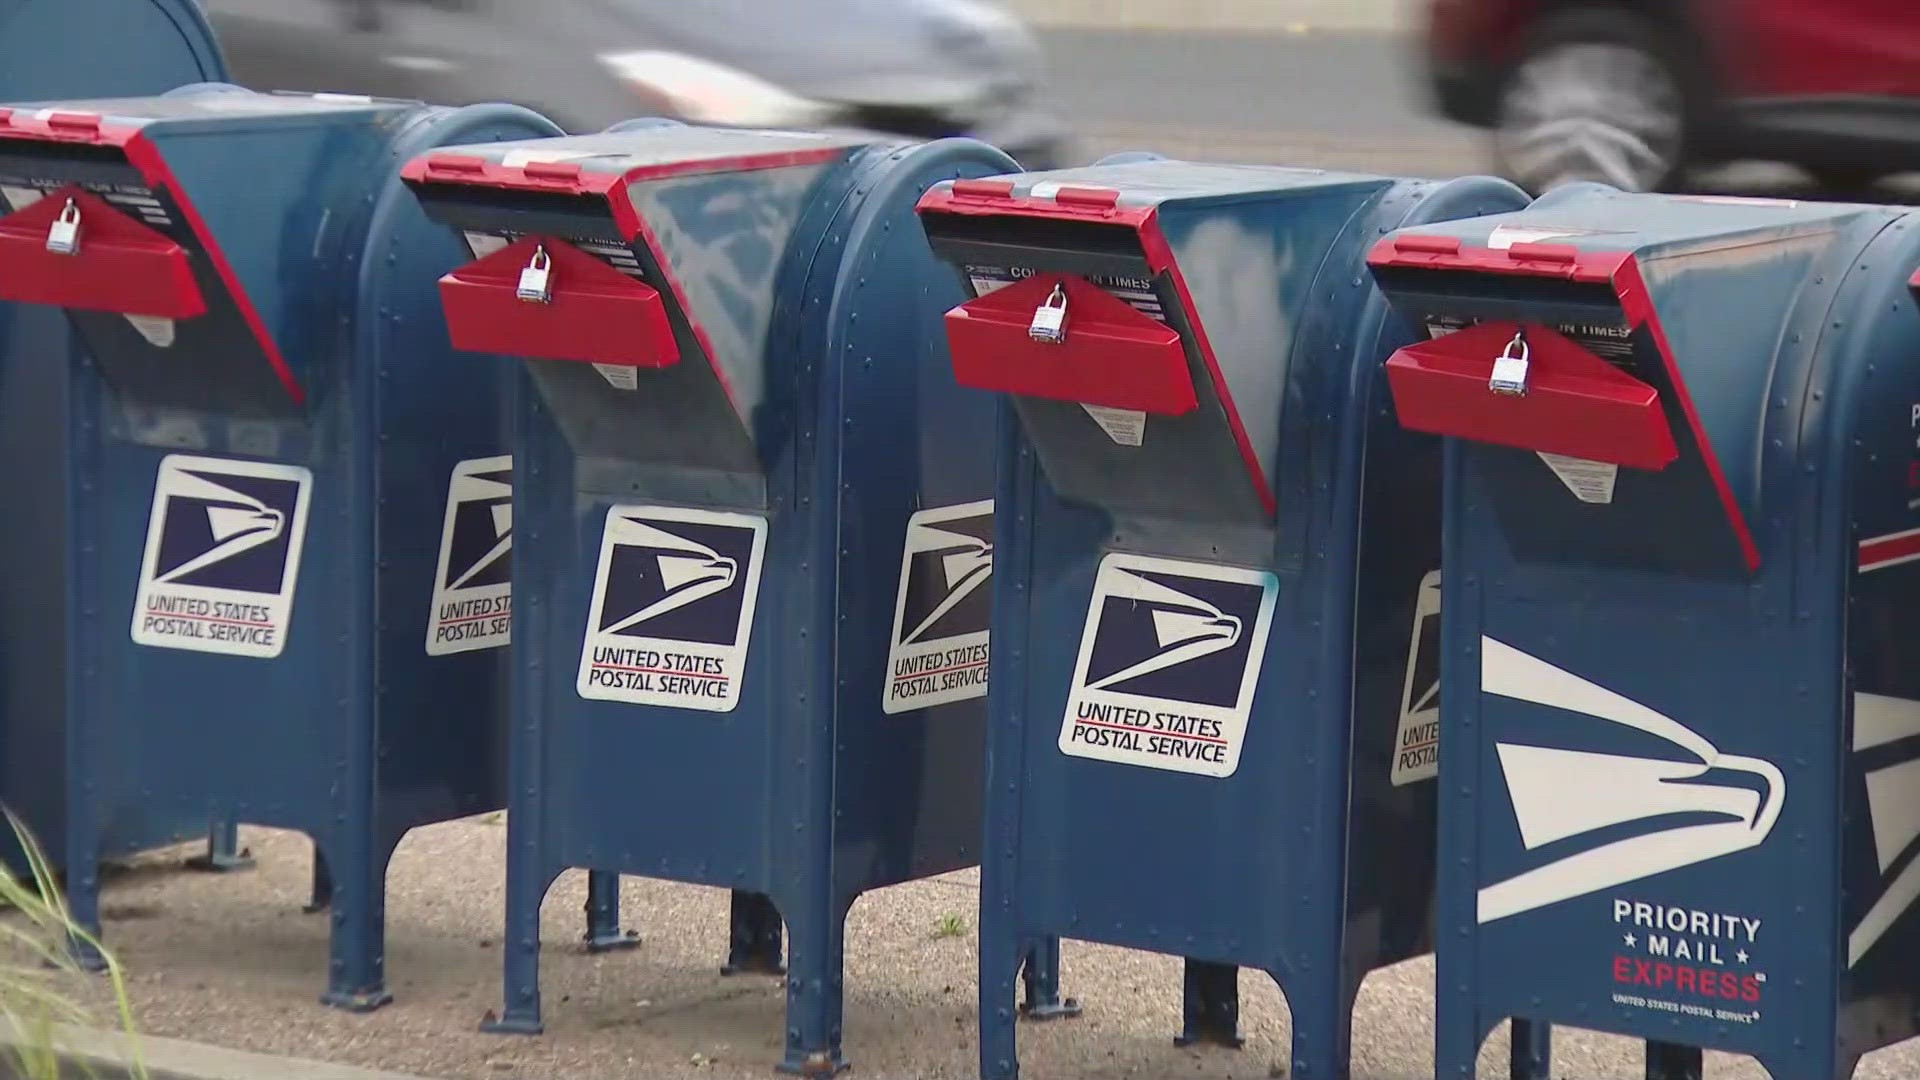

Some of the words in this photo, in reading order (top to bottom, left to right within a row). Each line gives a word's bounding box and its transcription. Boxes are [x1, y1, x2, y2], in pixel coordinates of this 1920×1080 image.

[147, 594, 209, 616] UNITED
[211, 601, 270, 622] STATES
[440, 598, 492, 620] UNITED
[143, 616, 204, 638] POSTAL
[207, 623, 275, 646] SERVICE
[436, 621, 486, 643] POSTAL
[593, 646, 660, 668] UNITED
[662, 653, 724, 674] STATES
[895, 652, 943, 676] UNITED
[945, 643, 988, 667] STATES
[588, 669, 654, 691] POSTAL
[657, 676, 729, 698] SERVICE
[891, 676, 939, 701] POSTAL
[940, 667, 989, 691] SERVICE
[1077, 701, 1150, 727] UNITED
[1152, 713, 1222, 738] STATES
[1403, 721, 1439, 746] UNITE
[1071, 724, 1142, 752] POSTAL
[1146, 736, 1227, 763] SERVICE
[1399, 745, 1437, 772] POSTA
[1613, 899, 1761, 942] PRIORITY
[1648, 934, 1724, 965] MAIL
[1613, 956, 1760, 1003] EXPRESS
[1612, 993, 1646, 1007] UNITED
[1647, 1000, 1680, 1013] STATES
[1680, 1005, 1714, 1018] POSTAL
